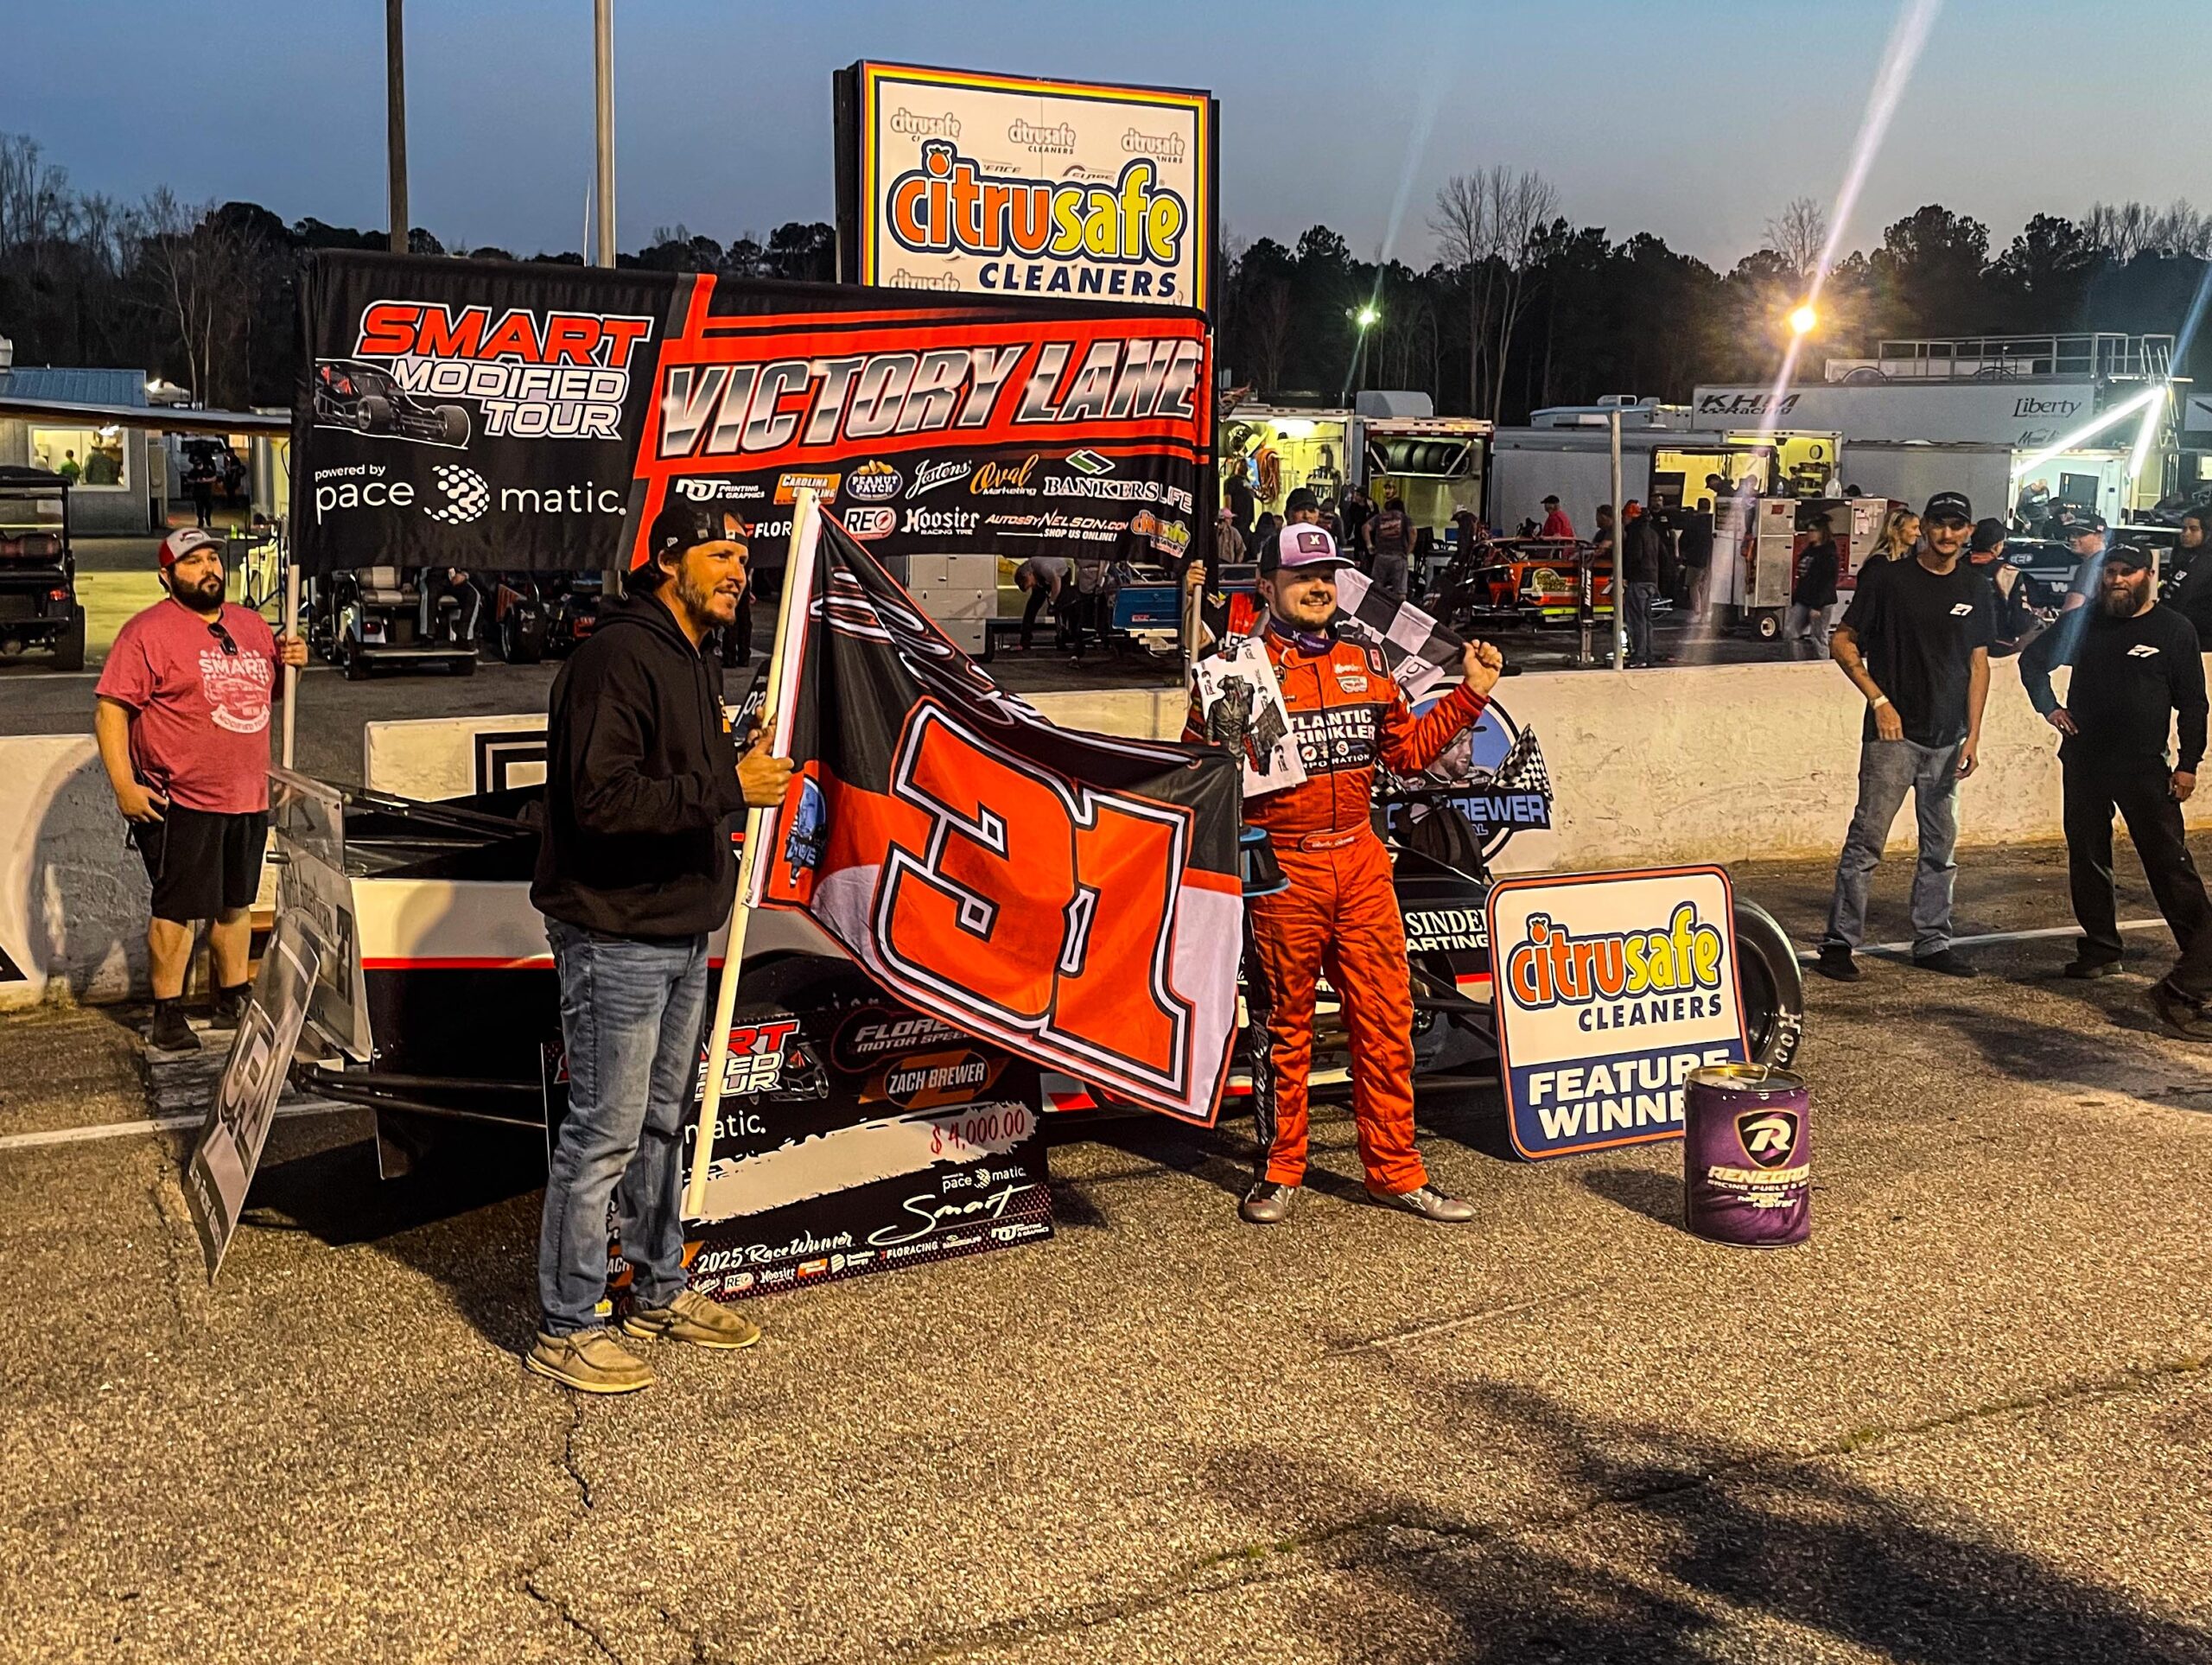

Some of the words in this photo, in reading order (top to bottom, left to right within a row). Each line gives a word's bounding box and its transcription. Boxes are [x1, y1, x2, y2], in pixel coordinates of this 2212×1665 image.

[891, 107, 962, 138] citrusafe
[1008, 118, 1077, 148] citrusafe
[1027, 145, 1074, 155] CLEANERS
[1122, 128, 1185, 156] citrusafe
[892, 145, 1184, 262] citrusafe
[979, 262, 1177, 297] CLEANERS
[353, 300, 654, 368] SMART
[392, 359, 629, 403] MODIFIED
[659, 345, 1022, 457] VICTORY
[1015, 340, 1204, 423] LANE
[2012, 397, 2082, 419] Liberty
[484, 399, 620, 439] TOUR
[315, 464, 365, 482] powered
[370, 464, 386, 476] by
[852, 475, 899, 486] PEANUT
[969, 454, 1039, 495] Oval
[719, 485, 760, 493] PRINTING
[725, 491, 765, 499] GRAPHICS
[856, 484, 893, 493] PATCH
[982, 486, 1036, 496] Marketing
[315, 481, 415, 526] pace
[901, 507, 980, 535] Hoosier
[1044, 529, 1066, 538] SHOP
[1068, 531, 1080, 539] US
[1082, 531, 1117, 543] ONLINE!
[199, 658, 267, 675] SMART
[1452, 795, 1546, 823] REWER
[1510, 906, 1719, 1005] citrusafe
[1579, 994, 1722, 1032] CLEANERS
[858, 1036, 916, 1053] MOTOR
[889, 1071, 927, 1094] ZACH
[928, 1063, 985, 1089] BREWER
[1743, 1118, 1791, 1151] R
[943, 1176, 973, 1194] pace
[698, 1248, 743, 1274] 2025
[745, 1244, 789, 1264] Race
[887, 1240, 938, 1259] FLORACING
